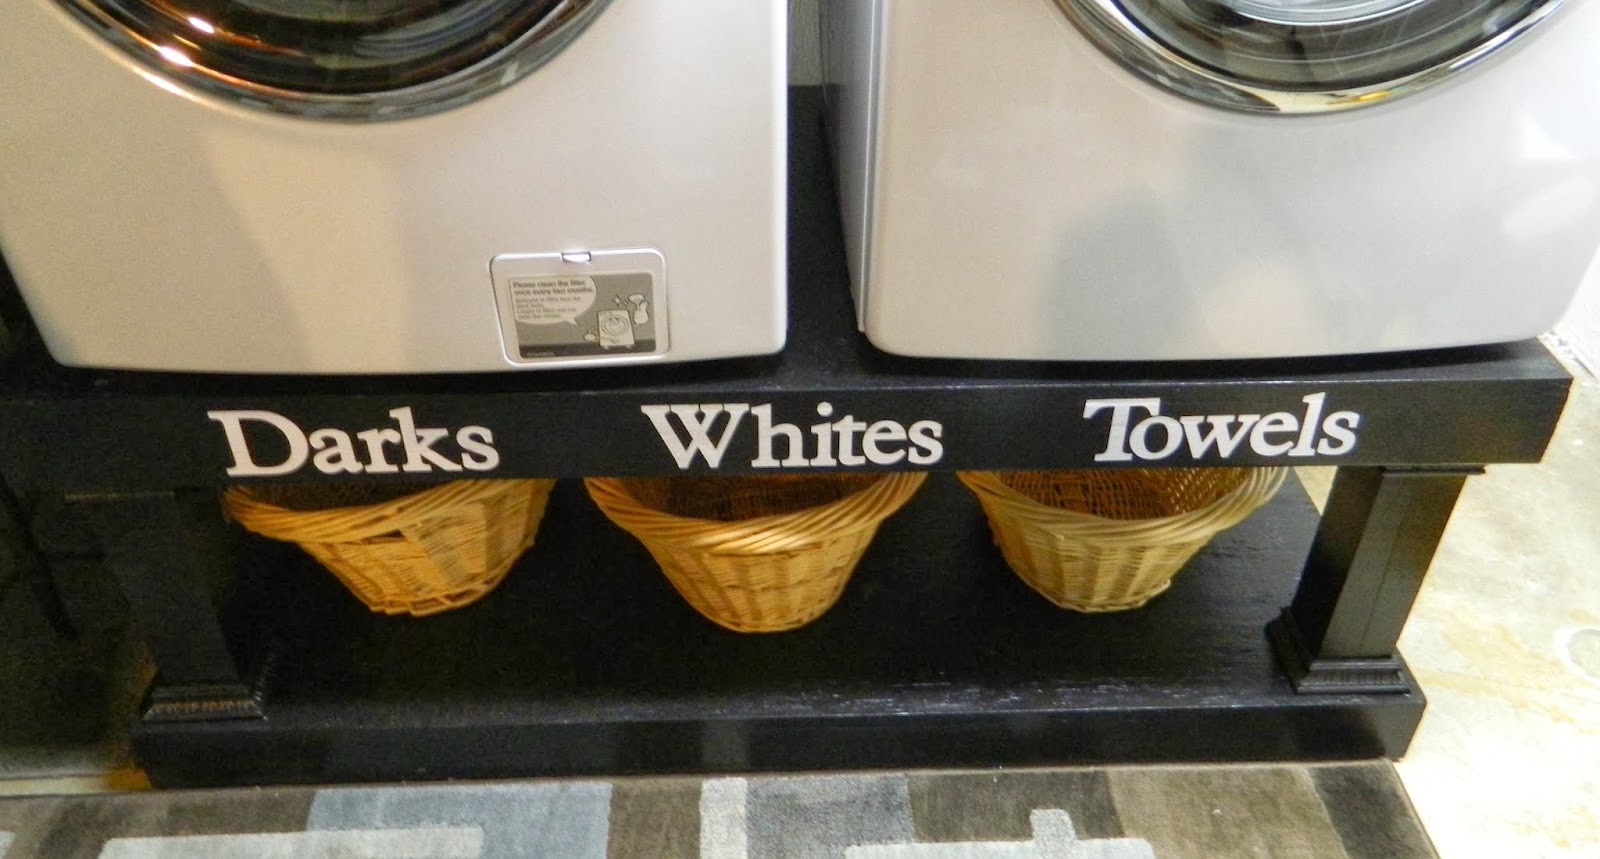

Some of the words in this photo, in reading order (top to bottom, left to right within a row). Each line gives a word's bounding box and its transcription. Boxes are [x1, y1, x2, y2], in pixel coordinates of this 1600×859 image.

[533, 288, 551, 296] every
[208, 407, 500, 477] Darks
[641, 402, 943, 470] Whites
[1083, 392, 1361, 463] Towels
